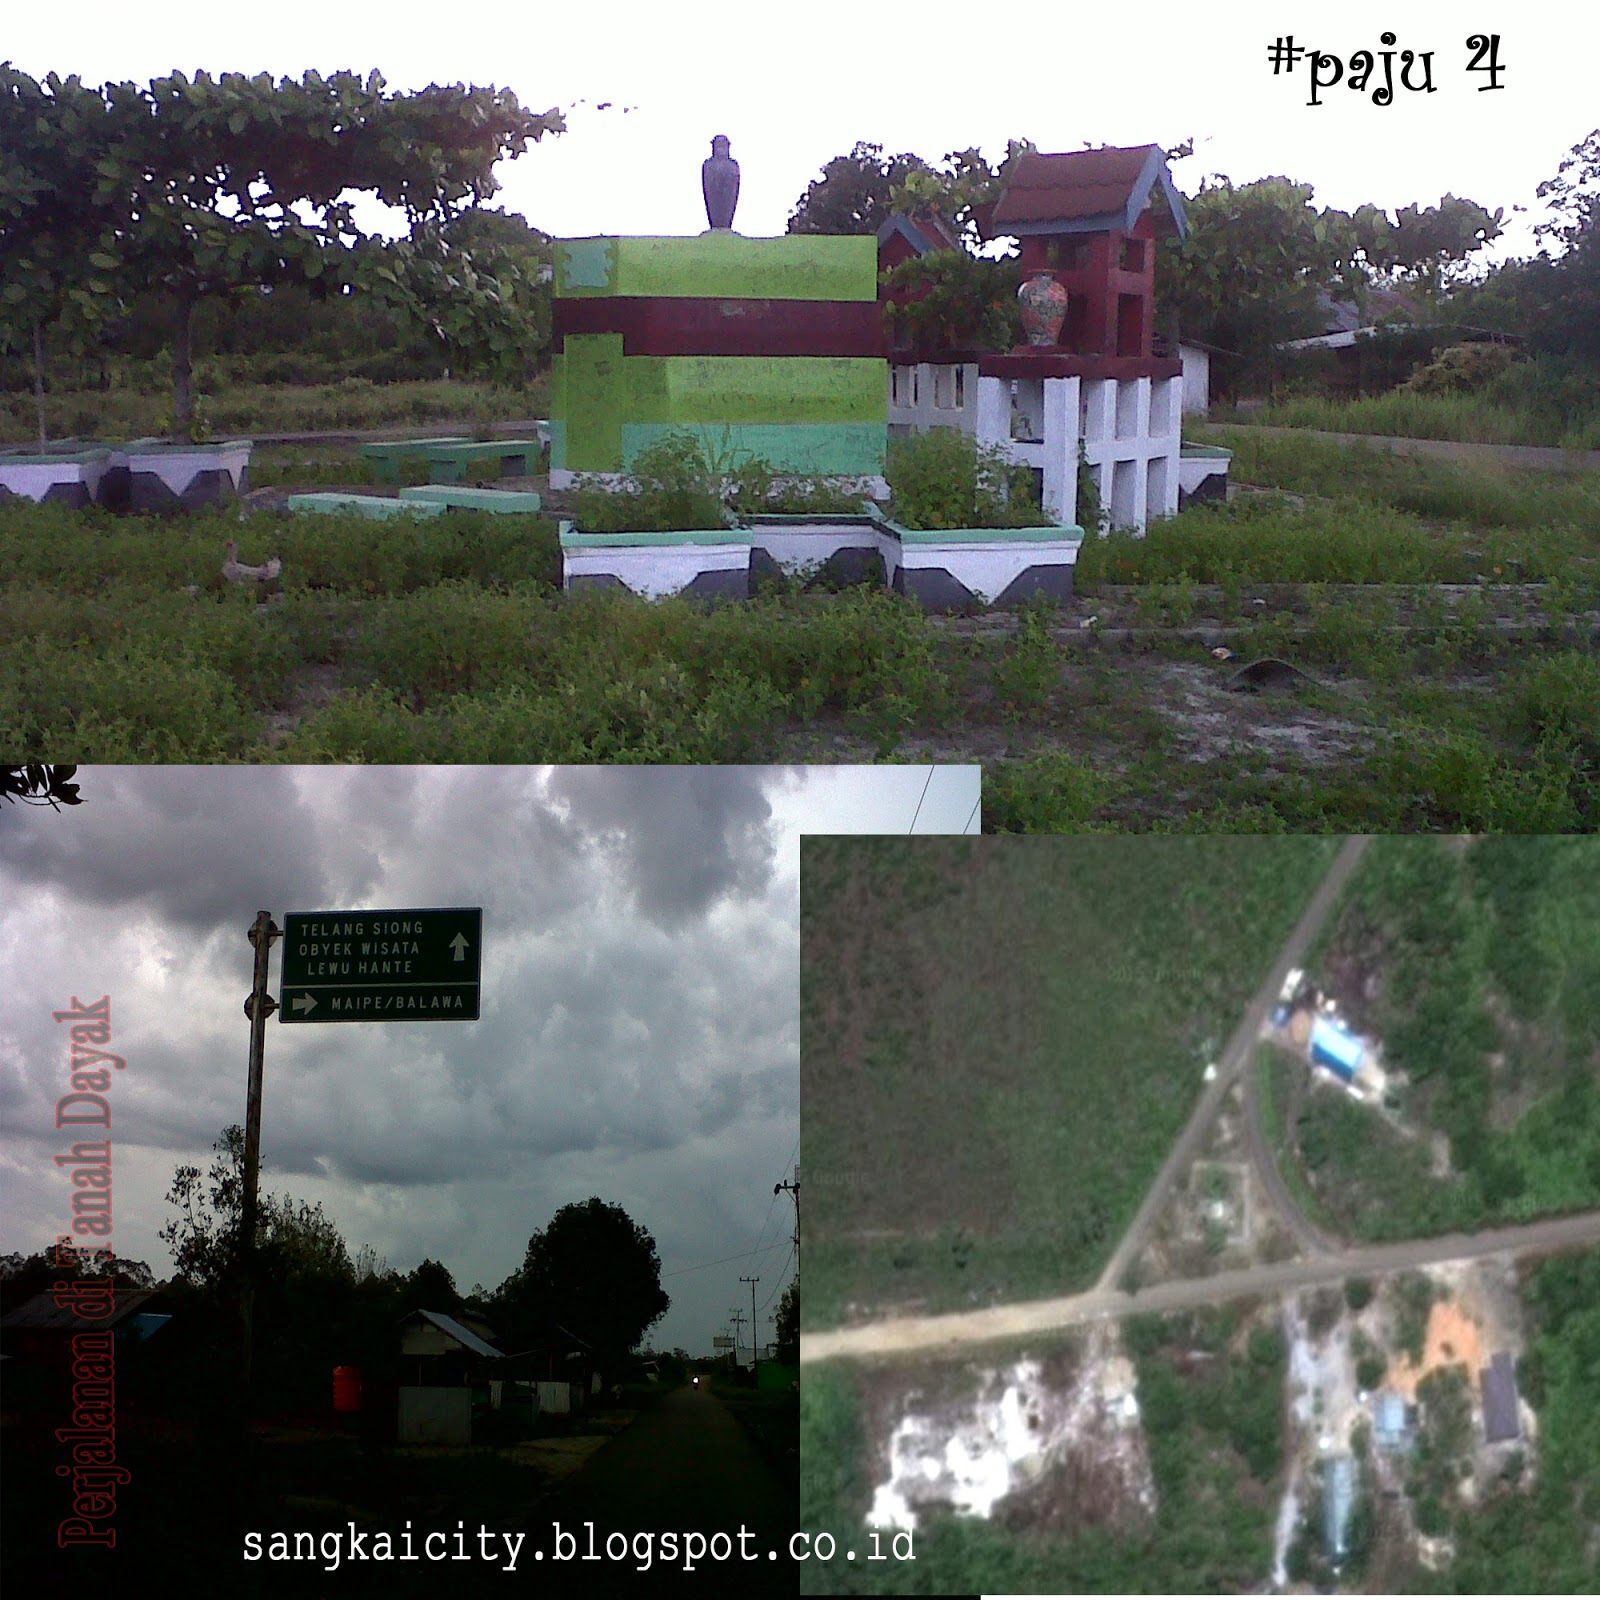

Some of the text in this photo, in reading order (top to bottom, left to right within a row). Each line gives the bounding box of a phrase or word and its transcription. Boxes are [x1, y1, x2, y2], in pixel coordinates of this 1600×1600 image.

[301, 921, 423, 937] TELANG SIONG
[299, 941, 420, 956] OBYEK WISATA
[307, 960, 412, 976] LEWU HANTE
[331, 995, 463, 1010] MAIPE/BALAWA
